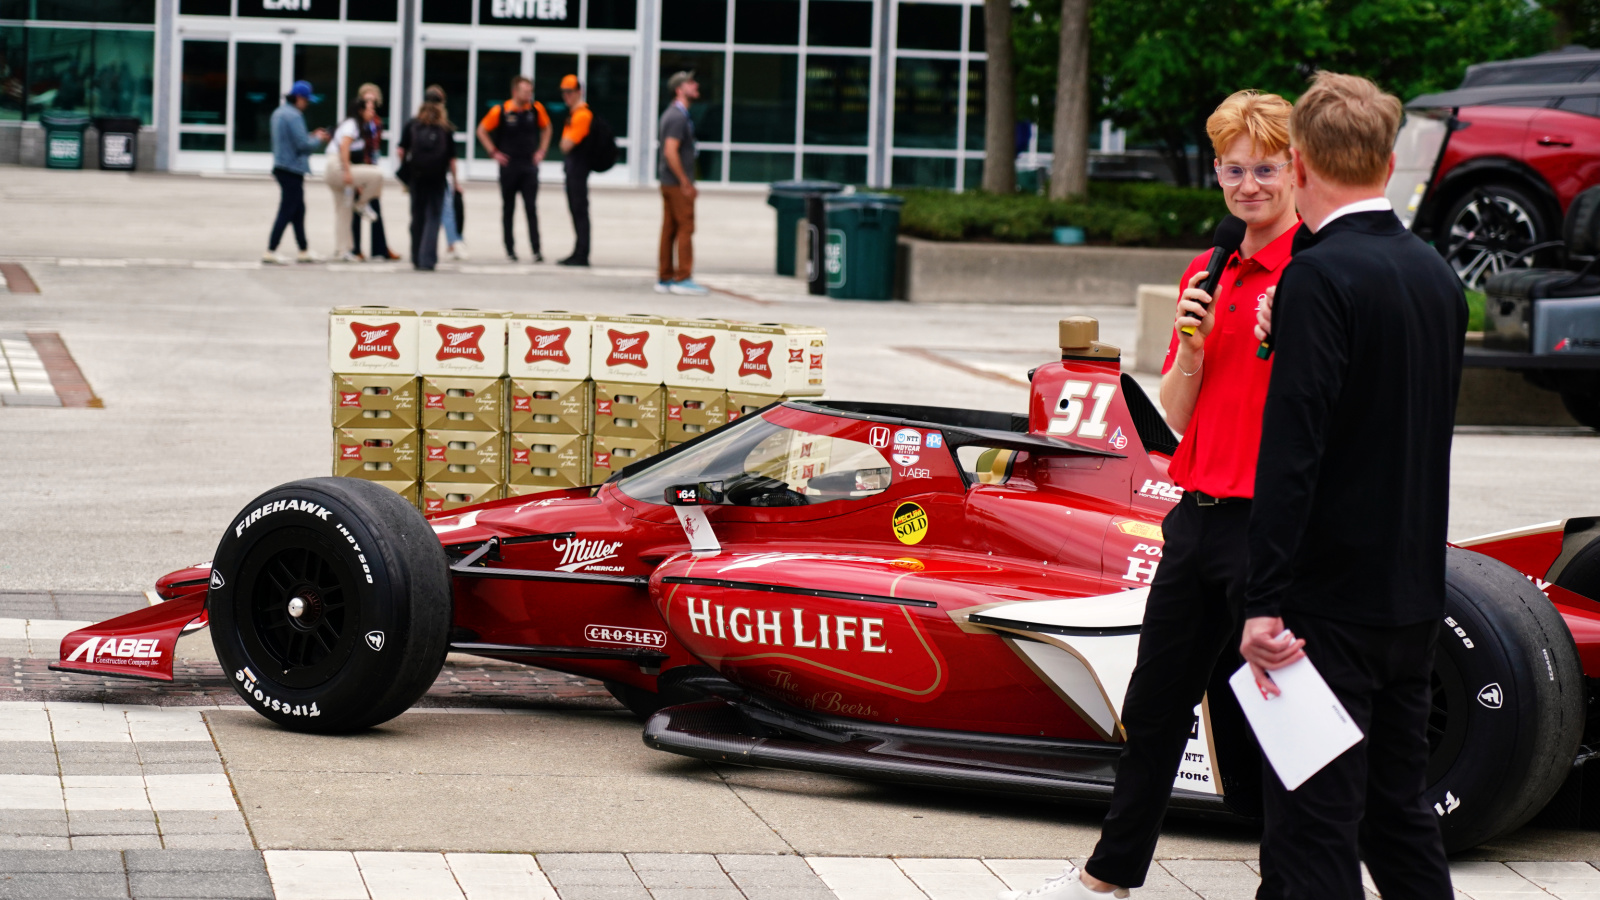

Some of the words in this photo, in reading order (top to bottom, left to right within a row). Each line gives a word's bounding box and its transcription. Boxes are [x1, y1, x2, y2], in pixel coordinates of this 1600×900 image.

[492, 0, 566, 19] ENTER
[361, 330, 389, 344] Miller
[447, 332, 474, 346] Miller
[535, 334, 561, 348] Miller
[616, 338, 640, 351] Miller
[686, 342, 707, 356] Miller
[746, 347, 765, 361] Miller
[1046, 380, 1117, 438] 51
[927, 434, 942, 447] PPG
[899, 467, 932, 479] J.ABEL
[1140, 479, 1185, 499] HRC
[896, 518, 926, 538] SOLD
[235, 499, 334, 538] FIREHAWK
[336, 523, 361, 552] INDY
[358, 554, 373, 584] 500
[553, 538, 623, 572] Miller
[686, 596, 784, 646] HIGH
[590, 628, 662, 644] CROSLEY
[1445, 616, 1474, 649] 500
[97, 638, 162, 657] ABEL
[128, 659, 150, 667] Company
[768, 669, 798, 692] The
[235, 669, 320, 717] Firestone
[804, 693, 821, 711] of
[1185, 752, 1204, 763] NTT
